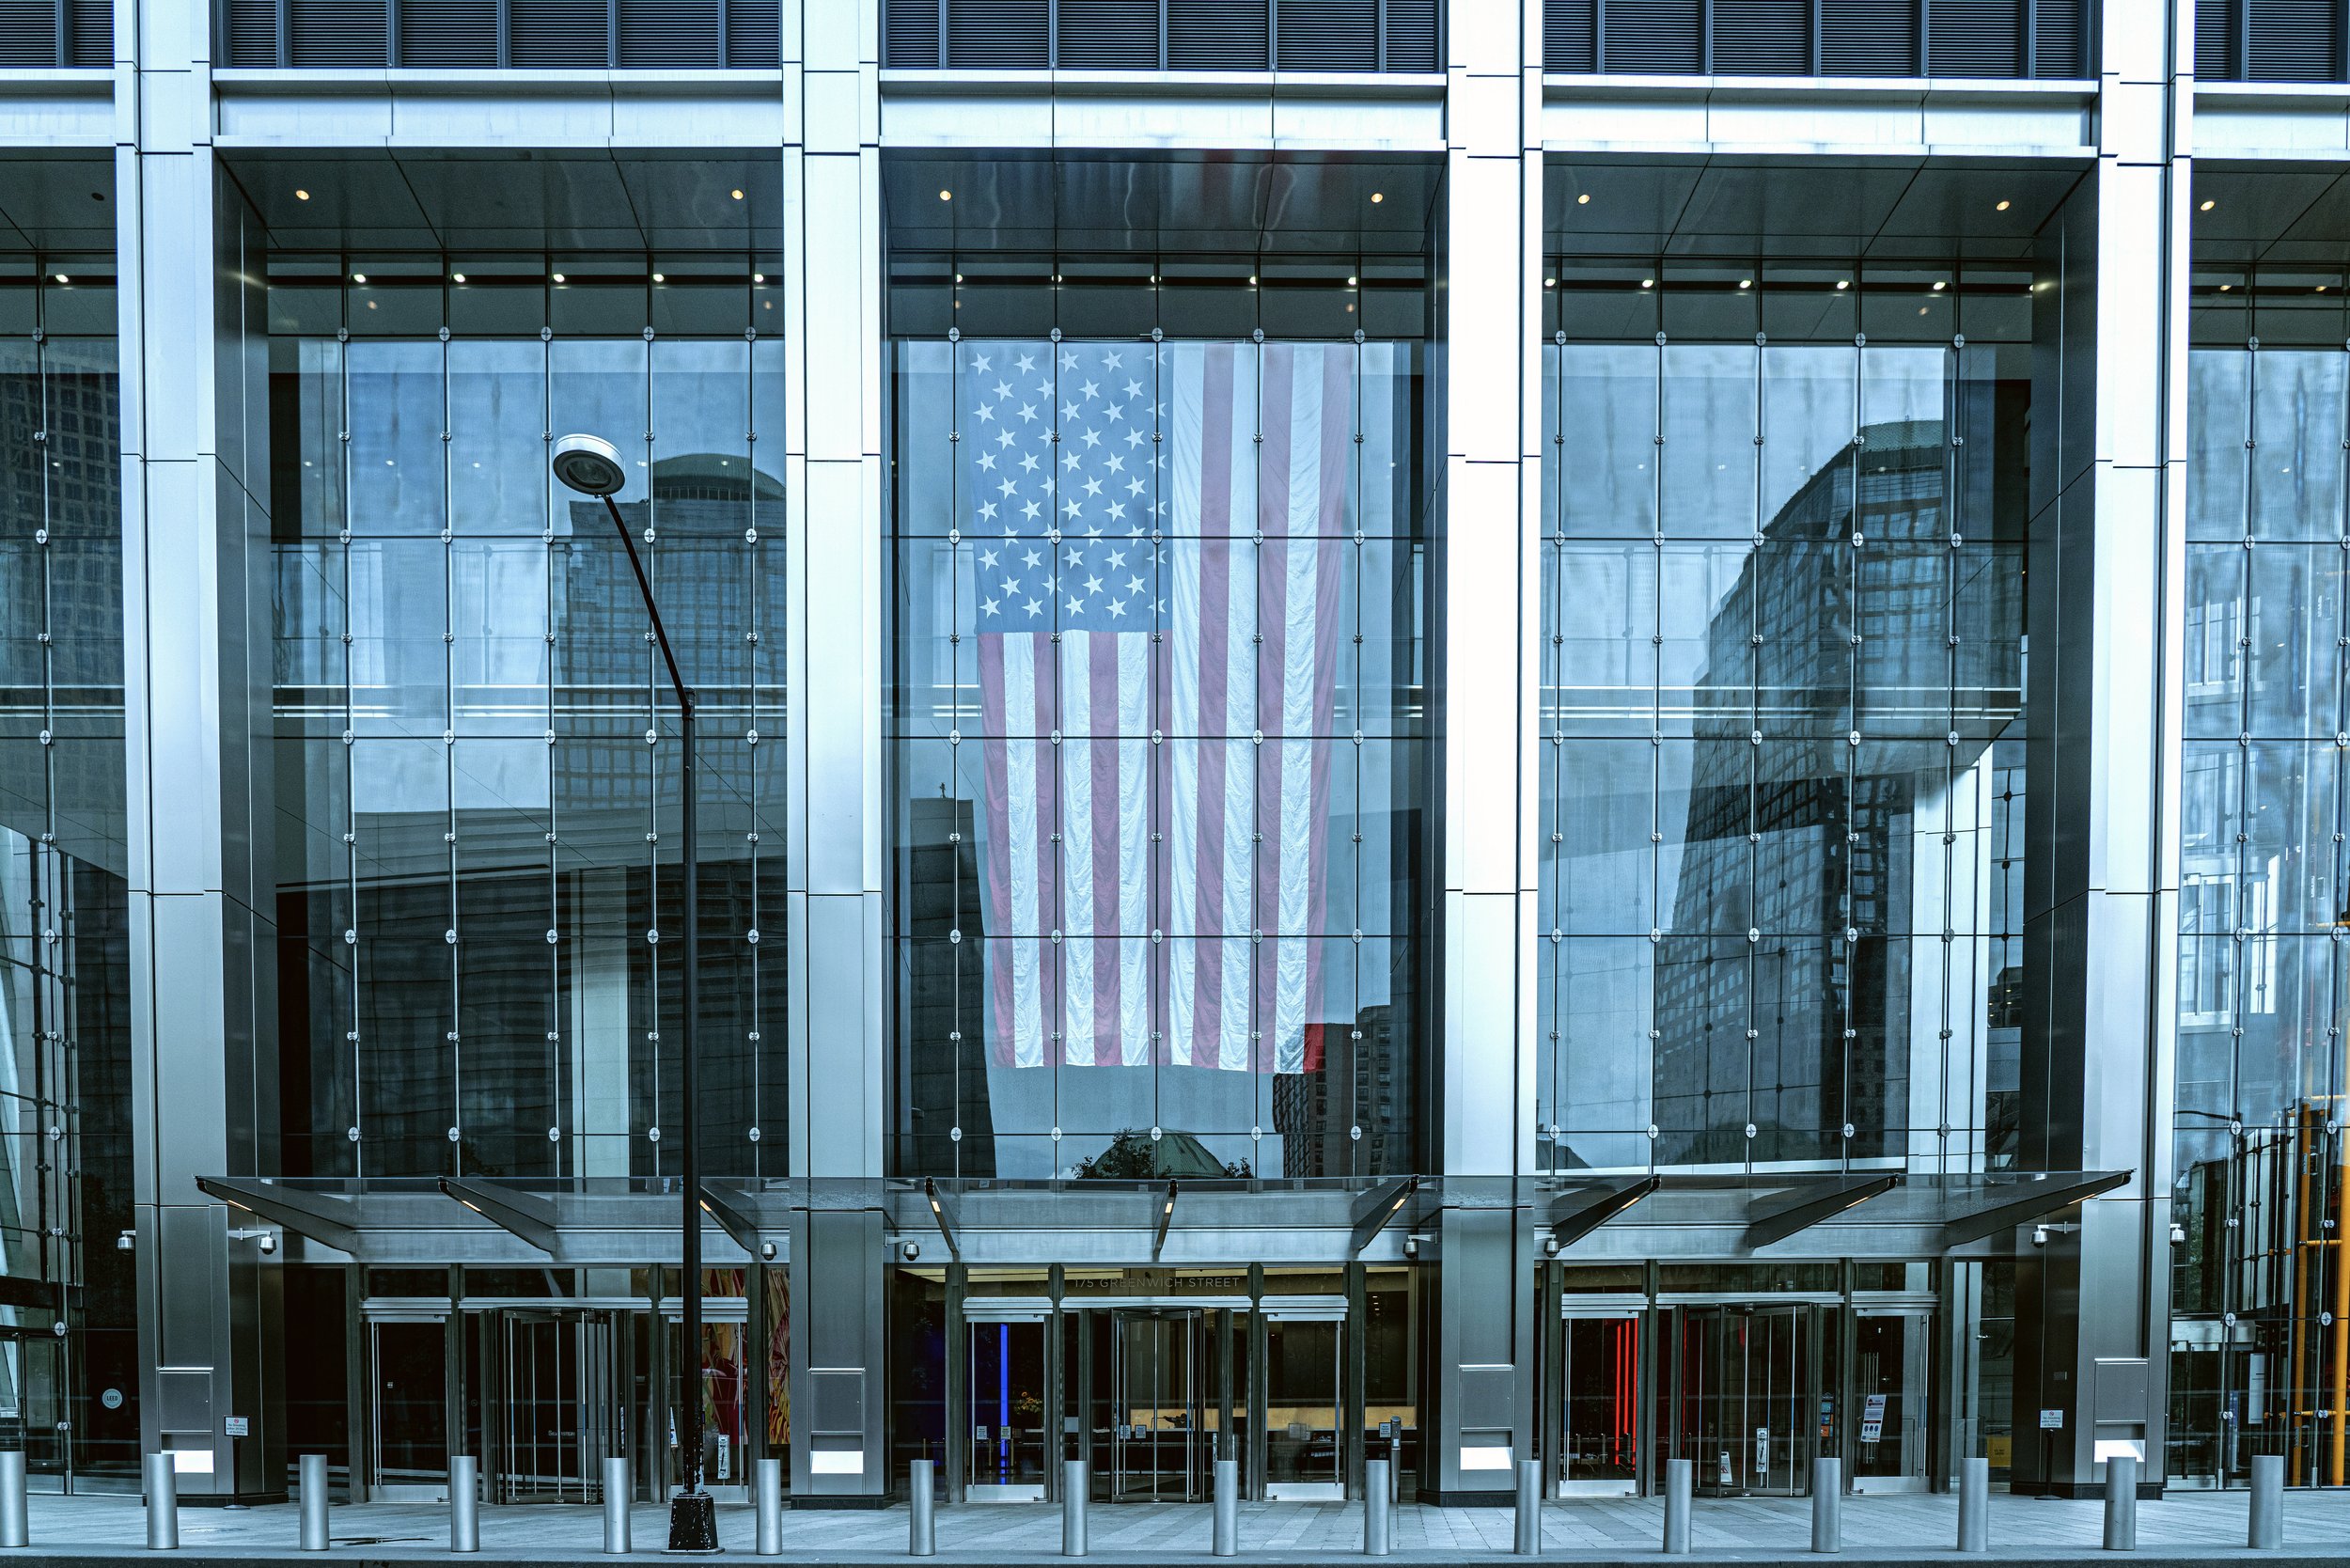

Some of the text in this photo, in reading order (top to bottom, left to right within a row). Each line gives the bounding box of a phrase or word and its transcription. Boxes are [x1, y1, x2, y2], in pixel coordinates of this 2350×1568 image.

[1074, 1278, 1240, 1288] 175 GREENWICH STREET
